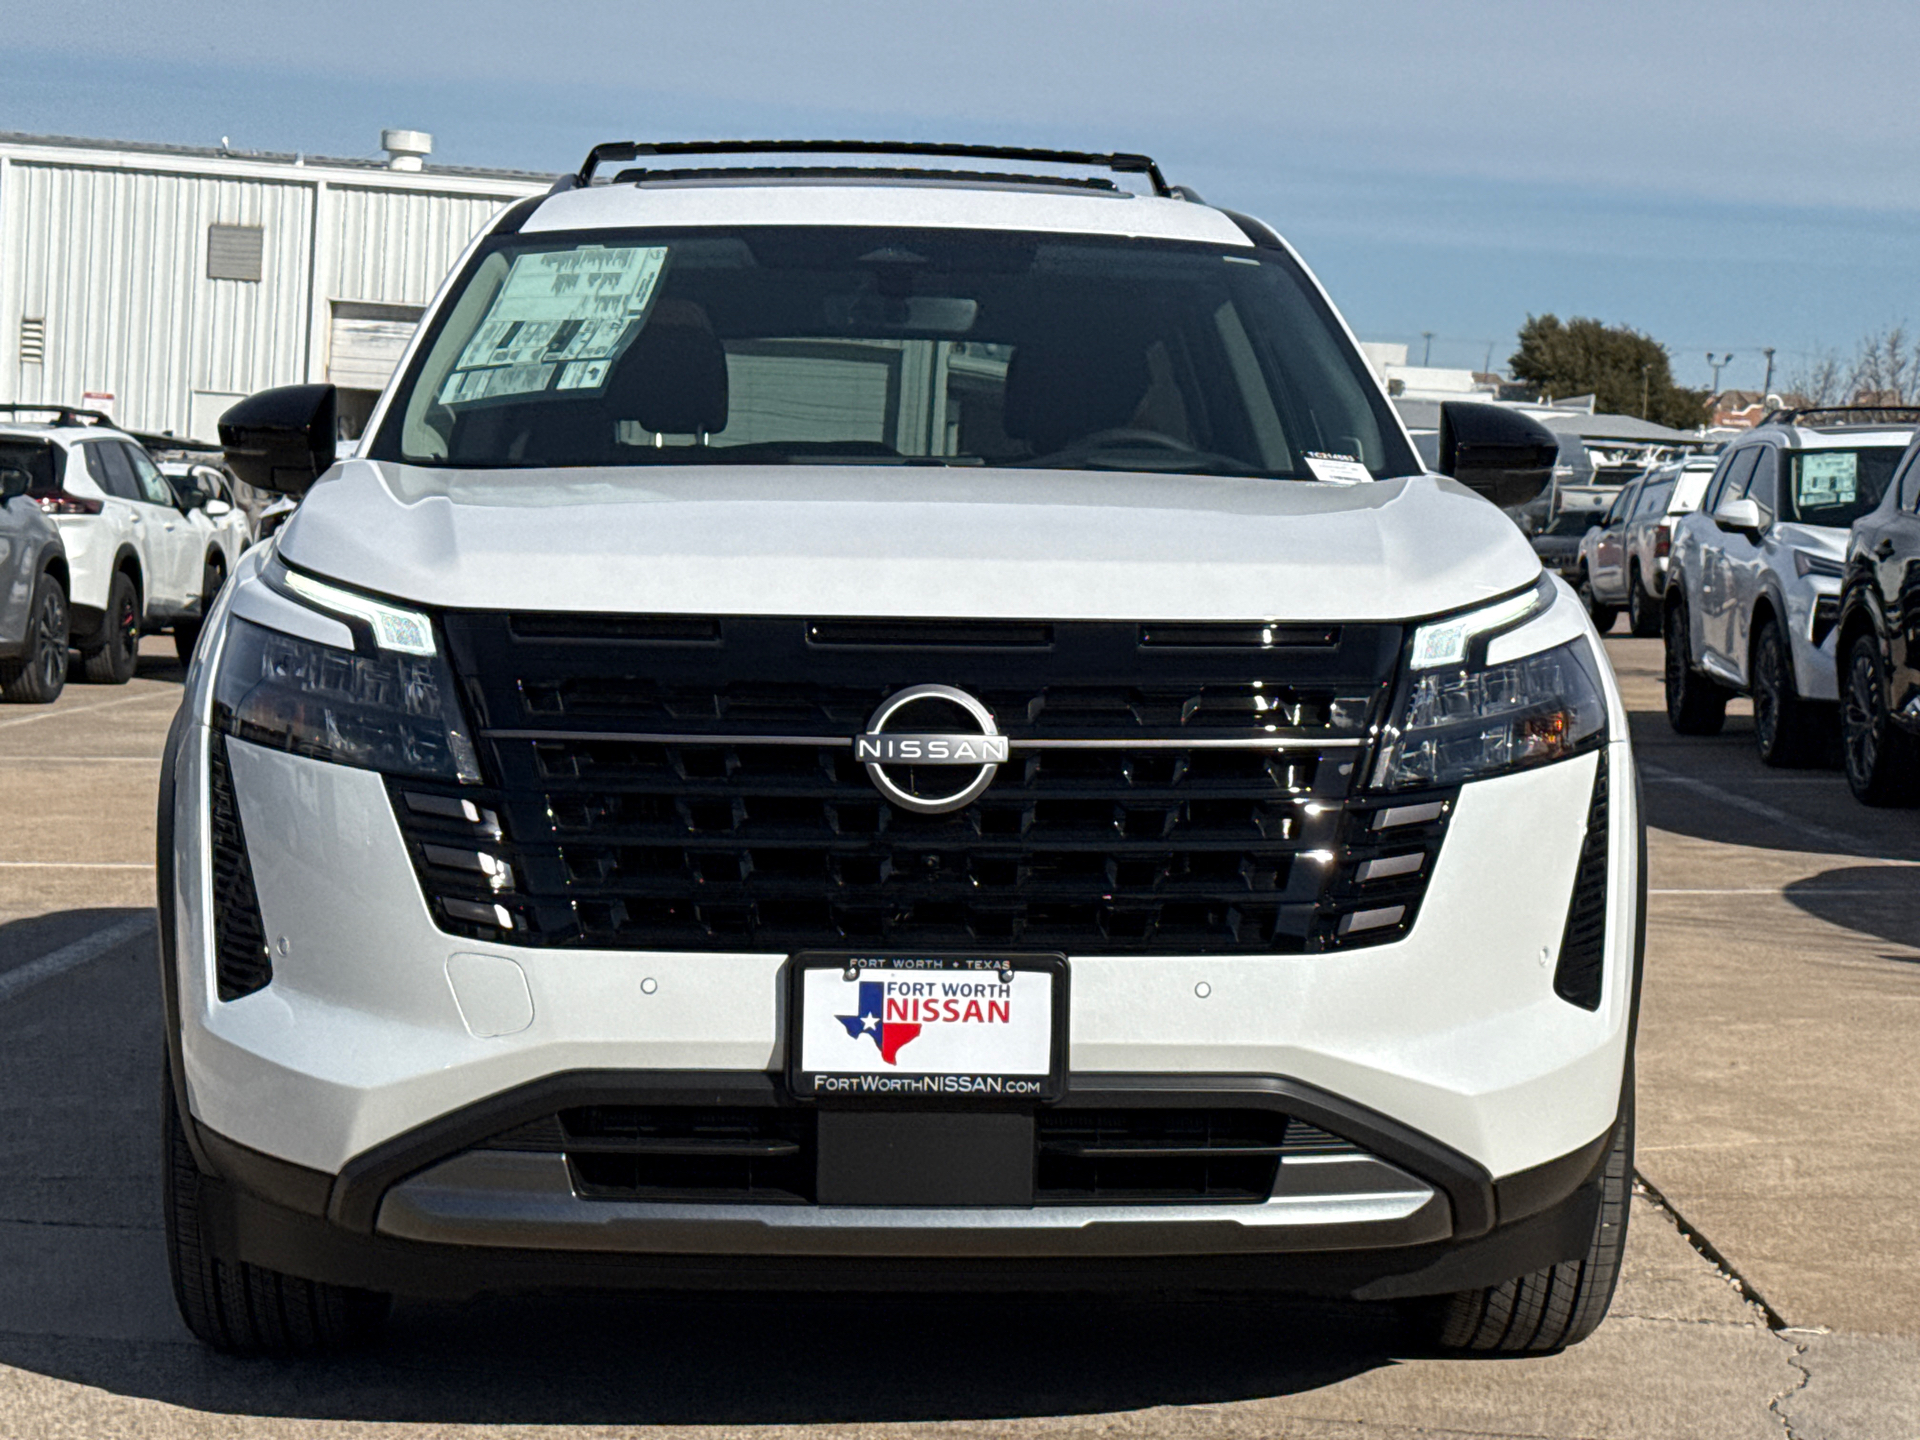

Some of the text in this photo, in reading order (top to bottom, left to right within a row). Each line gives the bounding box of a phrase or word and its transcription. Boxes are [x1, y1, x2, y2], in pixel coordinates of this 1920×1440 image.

[859, 739, 1004, 759] NISSAN
[849, 958, 1010, 970] FORT WORTH TEXAS
[887, 982, 1010, 998] FORT WORTH
[887, 998, 1010, 1023] NISSAN
